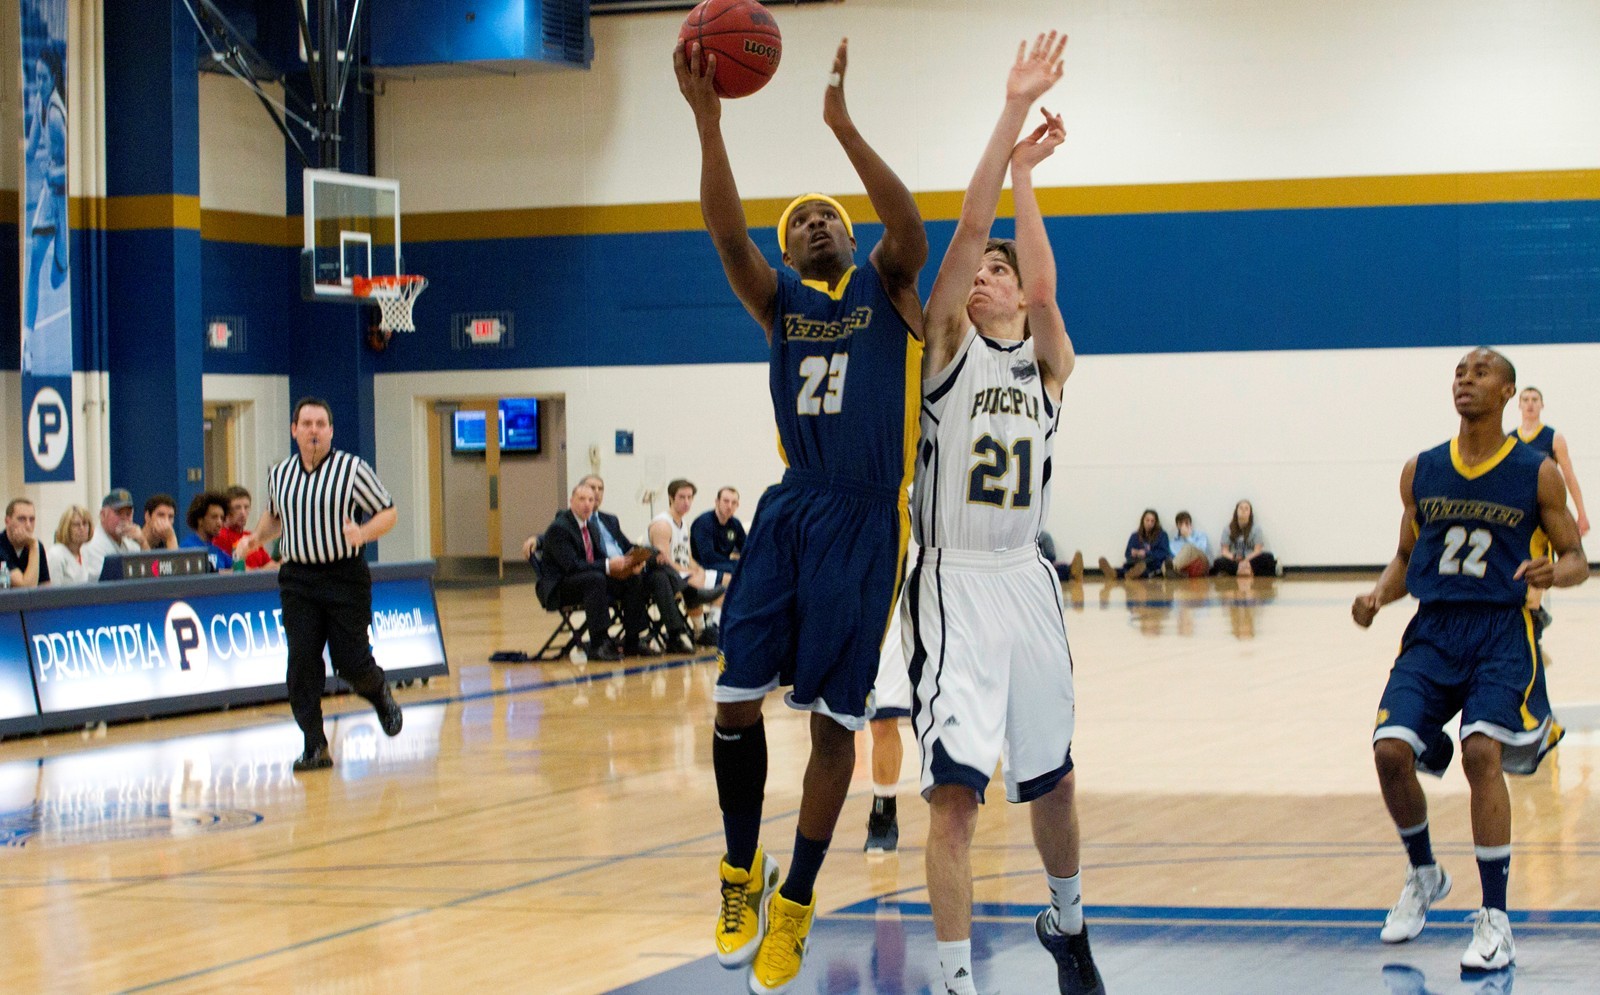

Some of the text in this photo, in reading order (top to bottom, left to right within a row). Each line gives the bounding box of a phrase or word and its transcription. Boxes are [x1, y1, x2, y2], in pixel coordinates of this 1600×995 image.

[475, 321, 494, 337] EXIT
[797, 352, 849, 415] 23
[37, 403, 62, 455] P
[966, 433, 1033, 510] 21
[1438, 525, 1493, 578] 22
[32, 608, 287, 683] PRINCIPIA P COLLE
[374, 609, 413, 632] Division
